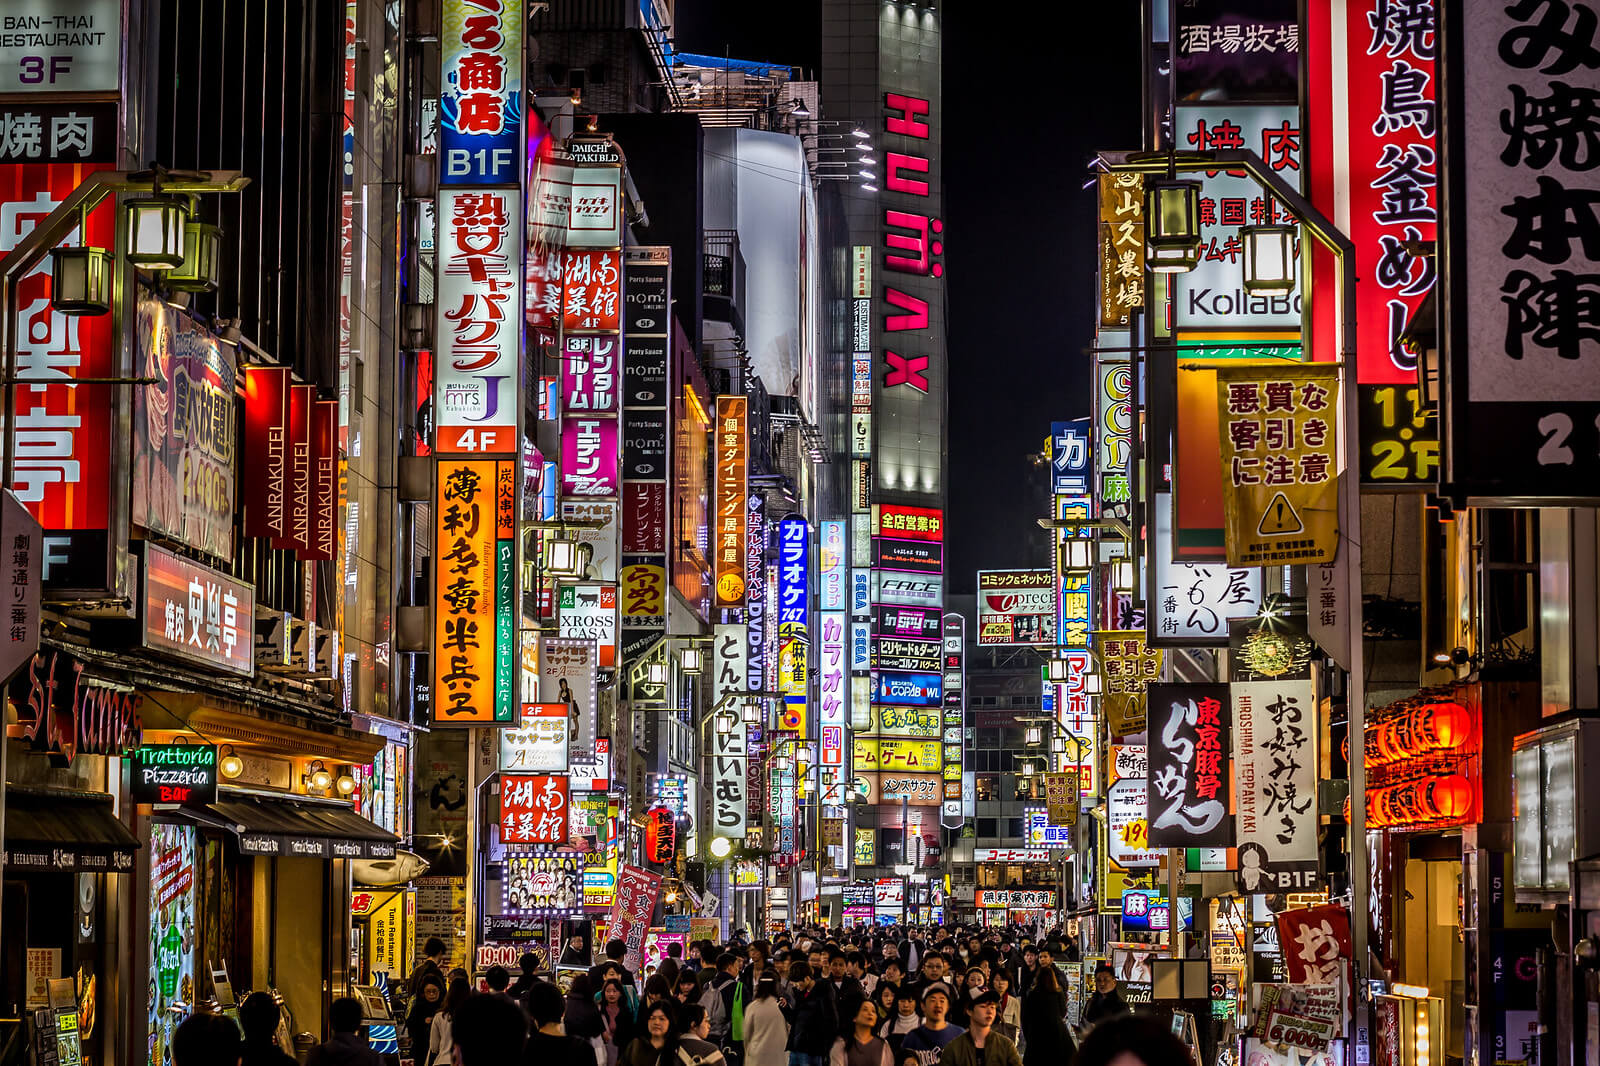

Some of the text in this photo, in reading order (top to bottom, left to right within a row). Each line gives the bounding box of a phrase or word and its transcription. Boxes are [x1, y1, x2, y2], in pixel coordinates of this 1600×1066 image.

[3, 15, 94, 30] BAN-THAI
[19, 56, 73, 84] 3F
[0, 111, 94, 159] 焼肉
[572, 144, 608, 153] DAIICHI
[448, 149, 512, 176] B1F
[600, 153, 619, 163] BLD
[1114, 191, 1143, 308] 山久農場
[581, 317, 600, 328] 4F
[569, 355, 590, 410] ルーム
[592, 337, 613, 410] レンタル
[1228, 383, 1329, 414] 悪質な
[456, 429, 497, 451] 4F
[577, 421, 600, 475] エデン
[1230, 418, 1329, 451] 客引き
[1231, 453, 1331, 487] に注意
[1371, 440, 1440, 479] 2F
[267, 426, 284, 538] ANRAKUTEI
[293, 442, 308, 549] ANRAKUTEI
[724, 418, 738, 563] 個室ダイニング居酒屋
[318, 457, 333, 560] ANRAKUTEI
[498, 468, 513, 530] 炭火串焼
[882, 512, 940, 533] 全店営業中
[782, 520, 805, 606] カラオケ
[10, 534, 30, 643] 劇場通り一番街
[855, 574, 867, 609] SEGA
[882, 579, 941, 593] FACE
[561, 615, 614, 628] XROSS
[781, 608, 804, 621] 747
[567, 627, 608, 639] CASA
[855, 628, 867, 665] SEGA
[792, 640, 806, 683] 麻雀
[822, 617, 842, 719] カラオケ
[1105, 660, 1158, 676] 客引き
[1069, 656, 1087, 732] マンボー
[527, 706, 543, 715] 2F
[1238, 695, 1252, 755] HIROSHIMA
[505, 733, 565, 745] マッサージ
[823, 727, 840, 748] 24
[1194, 696, 1222, 799] 東京豚骨
[141, 748, 214, 765] Trattoria
[882, 750, 919, 766] ゲーム
[1261, 694, 1312, 845] お好み焼き
[142, 769, 208, 785] Pizzeria
[883, 779, 937, 792] メンズサウナ
[159, 785, 192, 801] Bar
[987, 849, 1024, 860] コーヒー
[1278, 872, 1317, 888] B1F
[478, 945, 517, 967] 19:00
